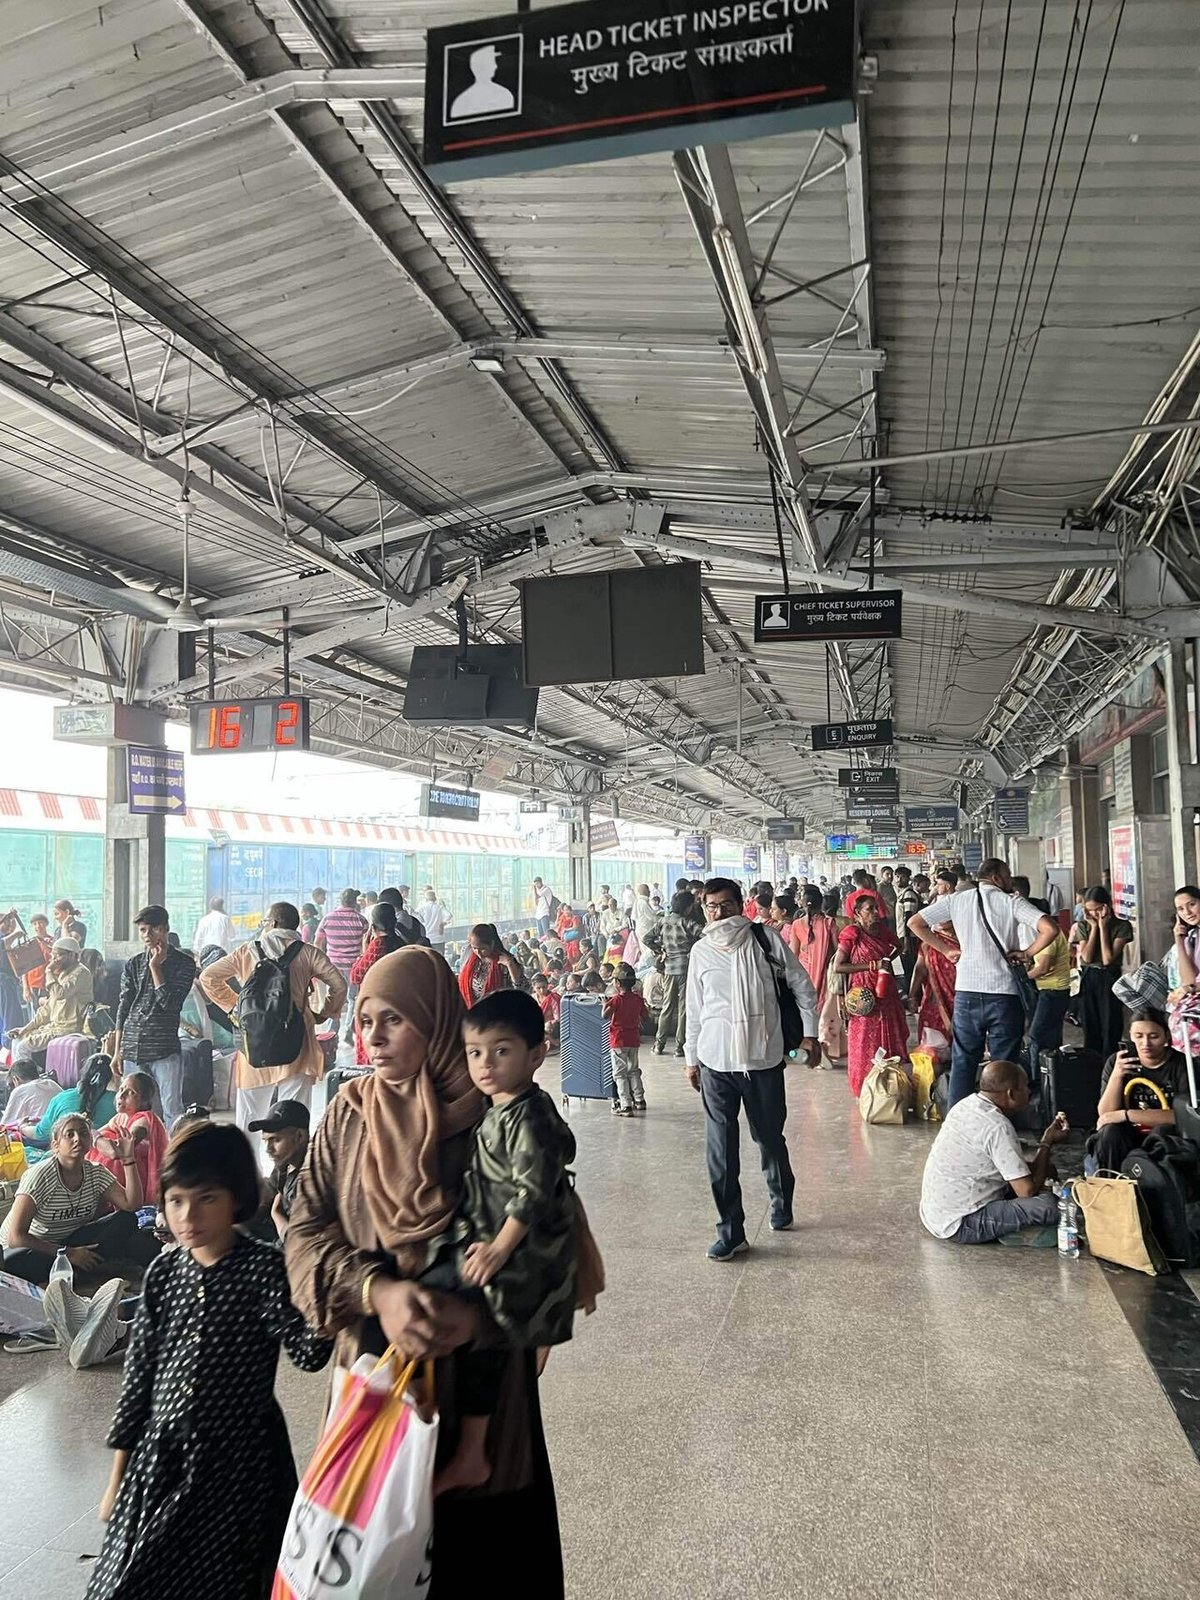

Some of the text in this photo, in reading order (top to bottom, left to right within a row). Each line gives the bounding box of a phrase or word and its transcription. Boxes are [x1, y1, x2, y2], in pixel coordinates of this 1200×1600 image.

[539, 29, 603, 59] HEAD
[607, 13, 688, 47] TICKET
[570, 23, 794, 95] मुख्य टिकट संग्रहकर्ता
[793, 599, 895, 611] CHIEF TICKET SUPERVISOR
[806, 613, 824, 626] मुख्य
[826, 611, 848, 623] टिकट
[848, 733, 877, 742] ENQUIRY
[872, 808, 890, 816] LOUNGE
[52, 1205, 92, 1220] TIMES
